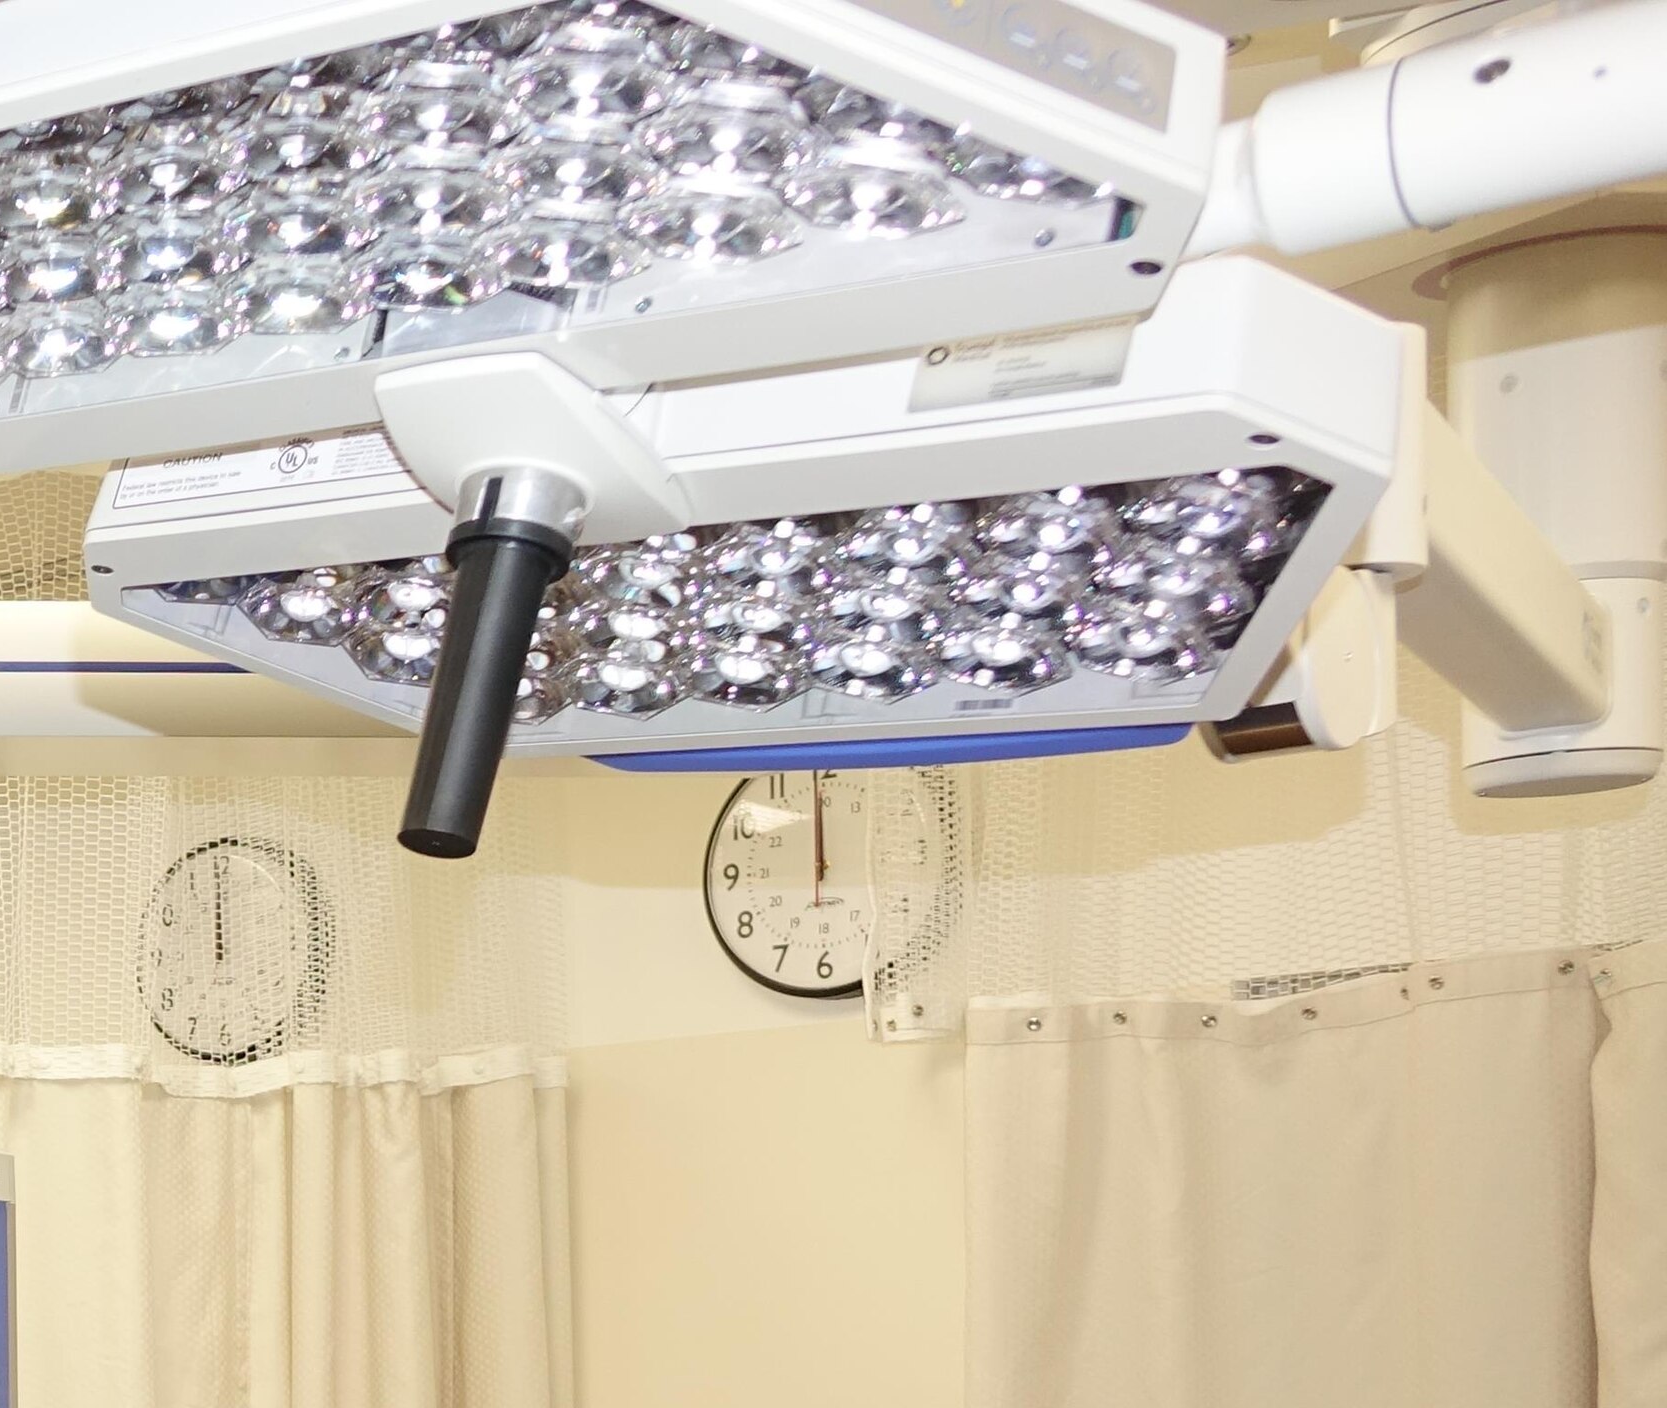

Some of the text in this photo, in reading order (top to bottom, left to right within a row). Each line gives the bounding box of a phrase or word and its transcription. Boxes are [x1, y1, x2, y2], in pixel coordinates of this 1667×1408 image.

[163, 452, 223, 468] CAUTION
[770, 773, 784, 799] 11
[851, 802, 861, 813] 13
[769, 836, 782, 848] 22
[723, 863, 739, 891] 9
[759, 868, 769, 878] 21
[769, 896, 783, 907] 20
[850, 910, 861, 922] 17
[737, 911, 753, 938] 8
[790, 918, 800, 928] 19
[819, 923, 829, 934] 18
[772, 944, 789, 973] 7
[817, 950, 833, 979] 6
